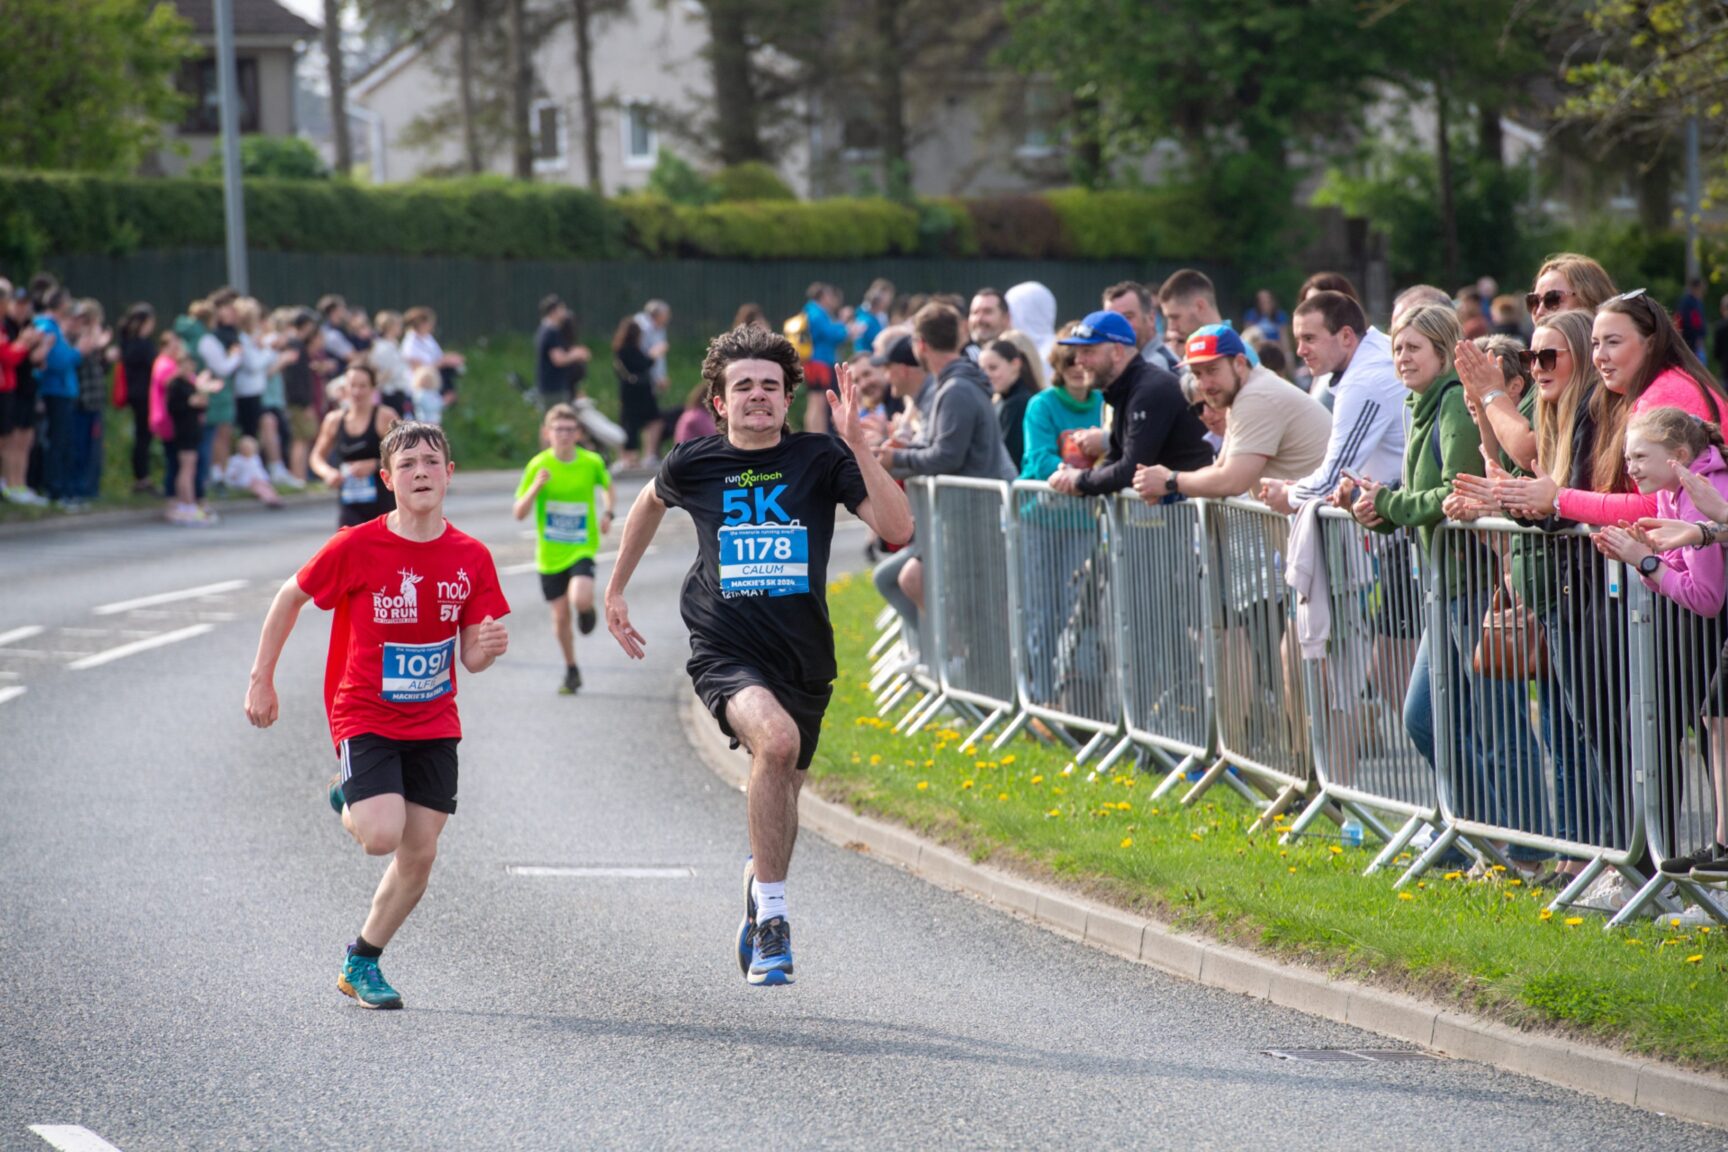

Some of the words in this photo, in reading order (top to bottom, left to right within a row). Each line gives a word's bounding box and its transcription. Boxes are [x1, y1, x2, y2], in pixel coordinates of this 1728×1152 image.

[723, 485, 791, 526] 5K
[733, 537, 791, 560] 1178
[742, 565, 784, 575] CALUM
[741, 589, 764, 598] MAY
[373, 595, 417, 608] ROOM
[374, 608, 388, 618] TO
[391, 607, 418, 618] RUN
[395, 649, 447, 676] 1091
